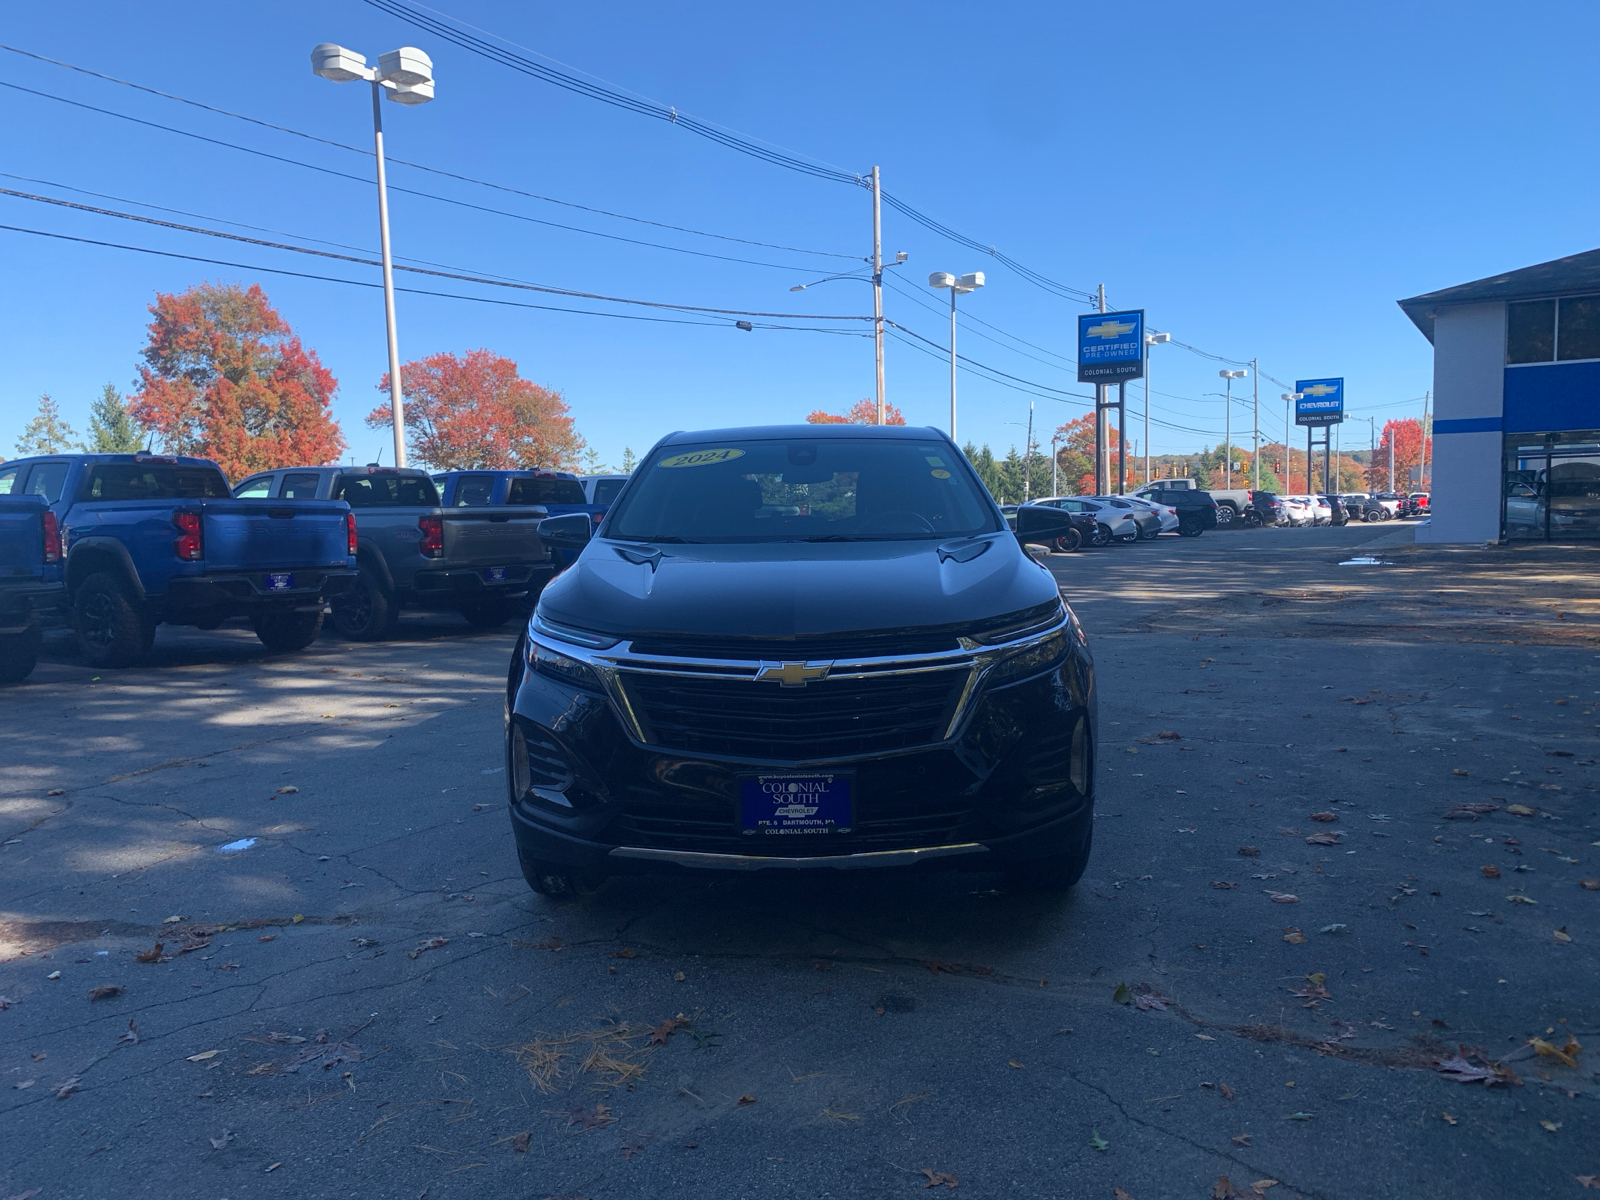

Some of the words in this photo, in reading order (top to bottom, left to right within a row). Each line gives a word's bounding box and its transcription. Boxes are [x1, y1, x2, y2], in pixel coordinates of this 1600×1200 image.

[1083, 342, 1138, 353] CERTIFIED
[1085, 349, 1135, 359] PRE-OWNED
[1084, 368, 1114, 376] COLONIAL
[1116, 366, 1137, 374] SOUTH
[1299, 401, 1340, 409] CHEVROLET
[672, 450, 731, 467] 2024
[762, 782, 830, 794] COLONIAL
[772, 793, 819, 804] SOUTH
[803, 827, 829, 835] SOUTH
